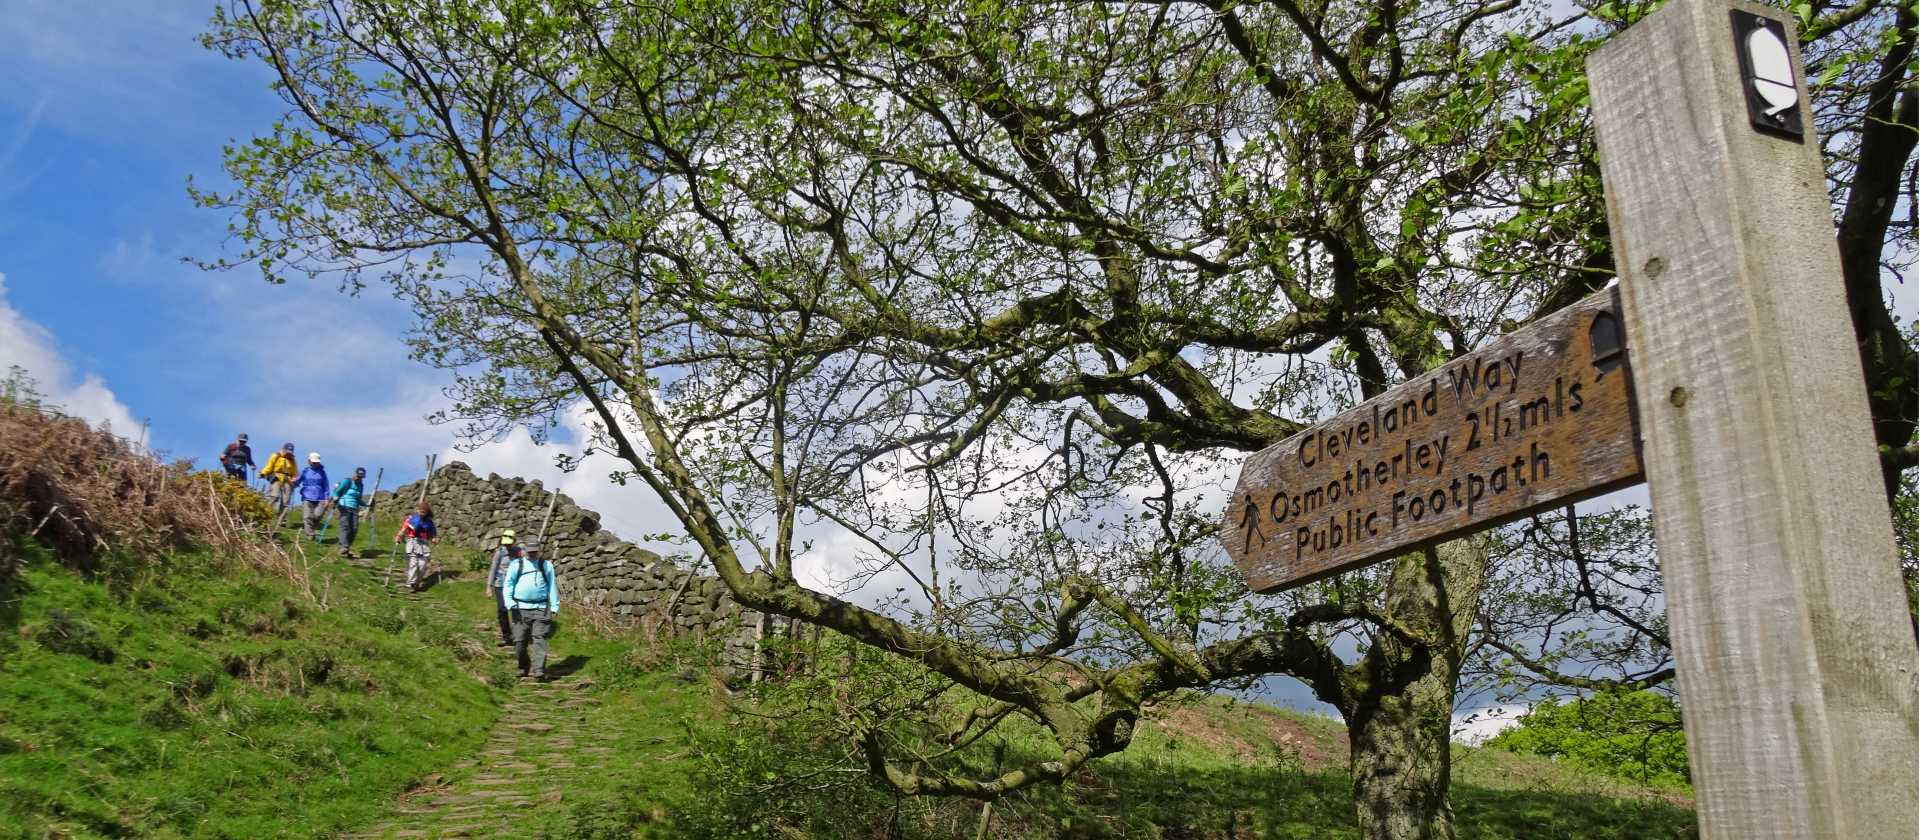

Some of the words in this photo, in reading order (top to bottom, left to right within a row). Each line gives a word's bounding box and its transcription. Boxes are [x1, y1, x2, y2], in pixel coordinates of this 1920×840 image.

[1299, 377, 1439, 469] Cleveland
[1449, 351, 1524, 405] Way
[1270, 435, 1449, 524] Osmotherley
[1296, 507, 1378, 560] Public
[1392, 442, 1551, 528] Footpath
